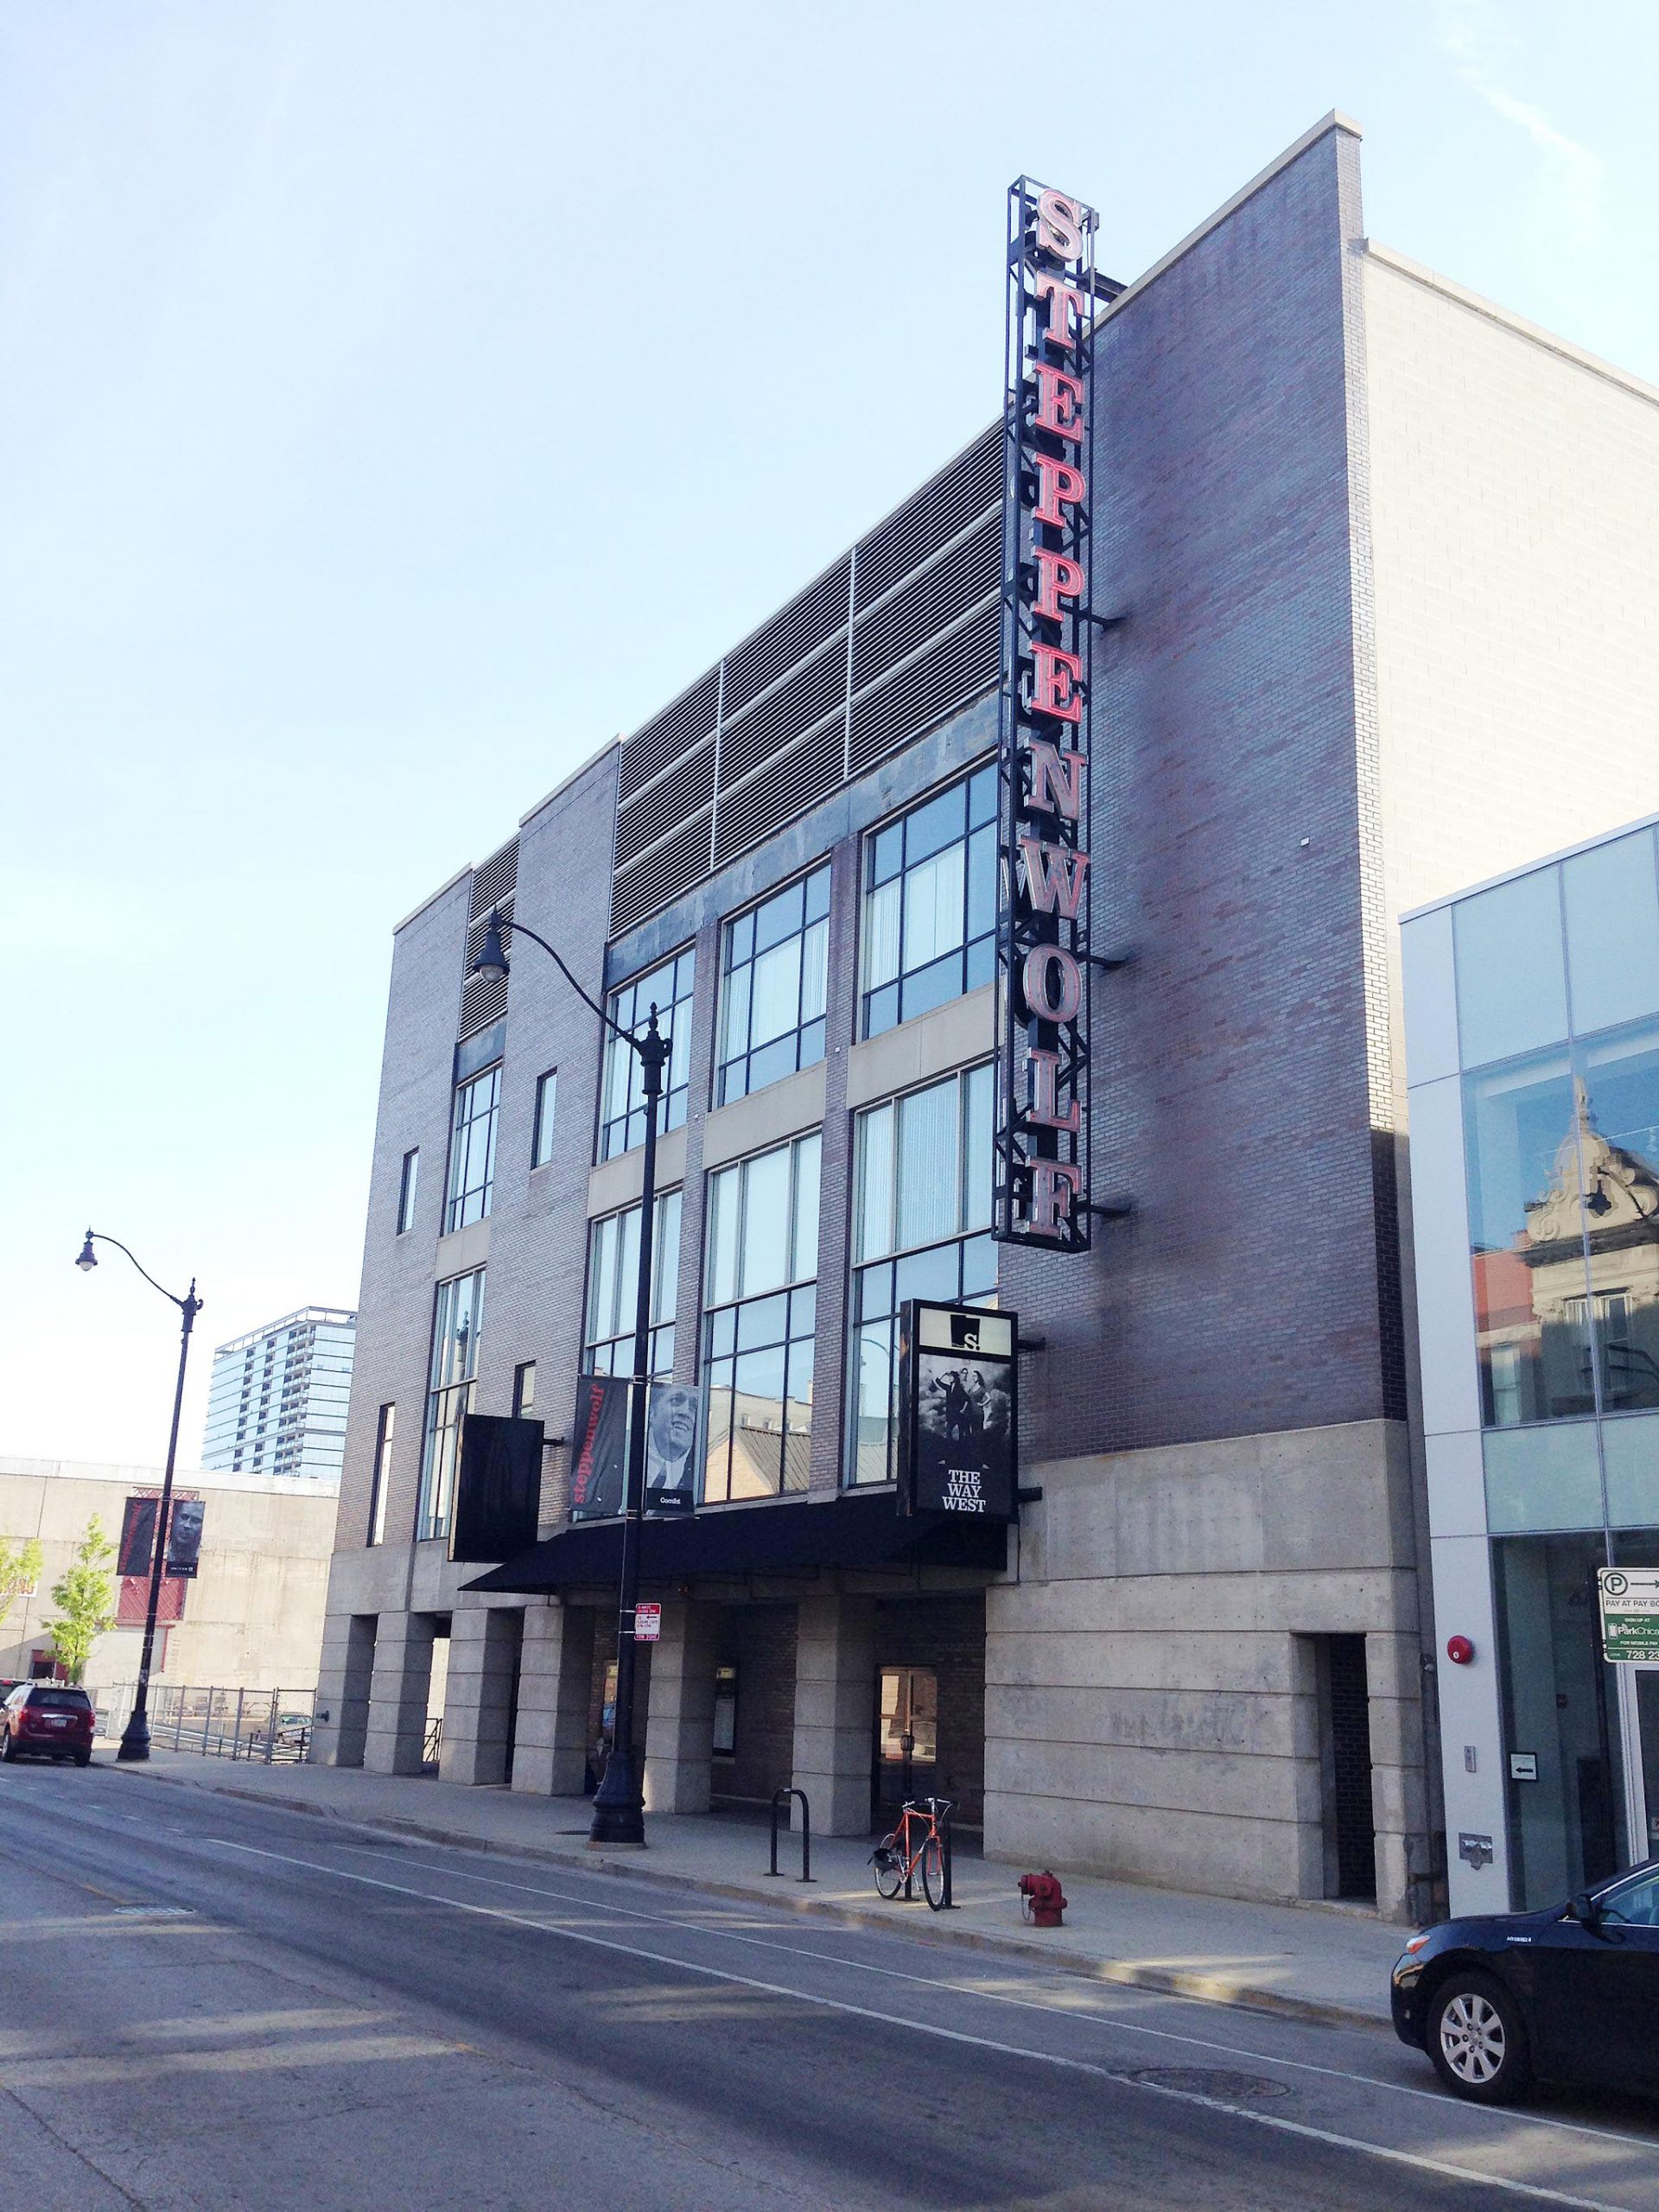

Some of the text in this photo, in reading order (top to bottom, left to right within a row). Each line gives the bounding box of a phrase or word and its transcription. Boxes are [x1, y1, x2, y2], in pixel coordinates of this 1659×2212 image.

[1019, 187, 1088, 1239] STEPPENWOLF
[574, 1383, 604, 1504] steppenwolf
[948, 1469, 981, 1484] THE
[947, 1483, 982, 1498] WAY
[942, 1496, 986, 1513] WEST
[1626, 1650, 1646, 1660] 728
